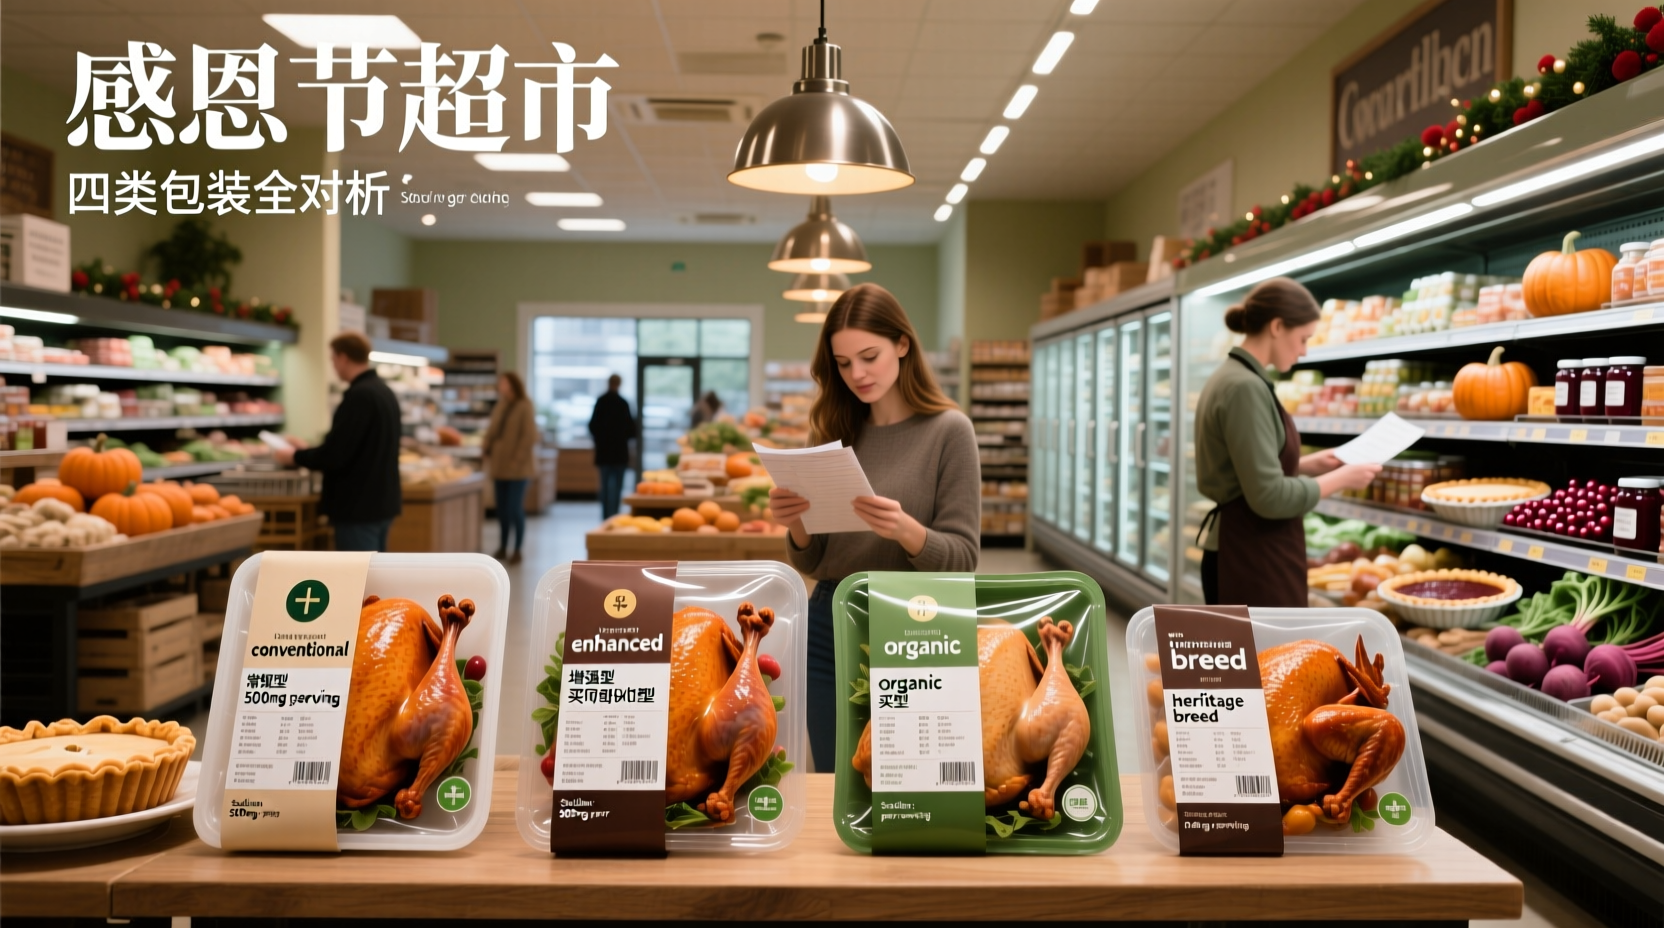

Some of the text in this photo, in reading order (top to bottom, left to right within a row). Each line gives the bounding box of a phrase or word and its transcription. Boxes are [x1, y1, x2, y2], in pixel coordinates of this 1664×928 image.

[251, 641, 350, 657] conventional
[571, 633, 664, 653] enhanced
[884, 634, 961, 660] organic
[1171, 647, 1247, 671] breed
[878, 673, 943, 694] organic
[244, 691, 287, 708] 500mg
[1173, 708, 1219, 723] breed
